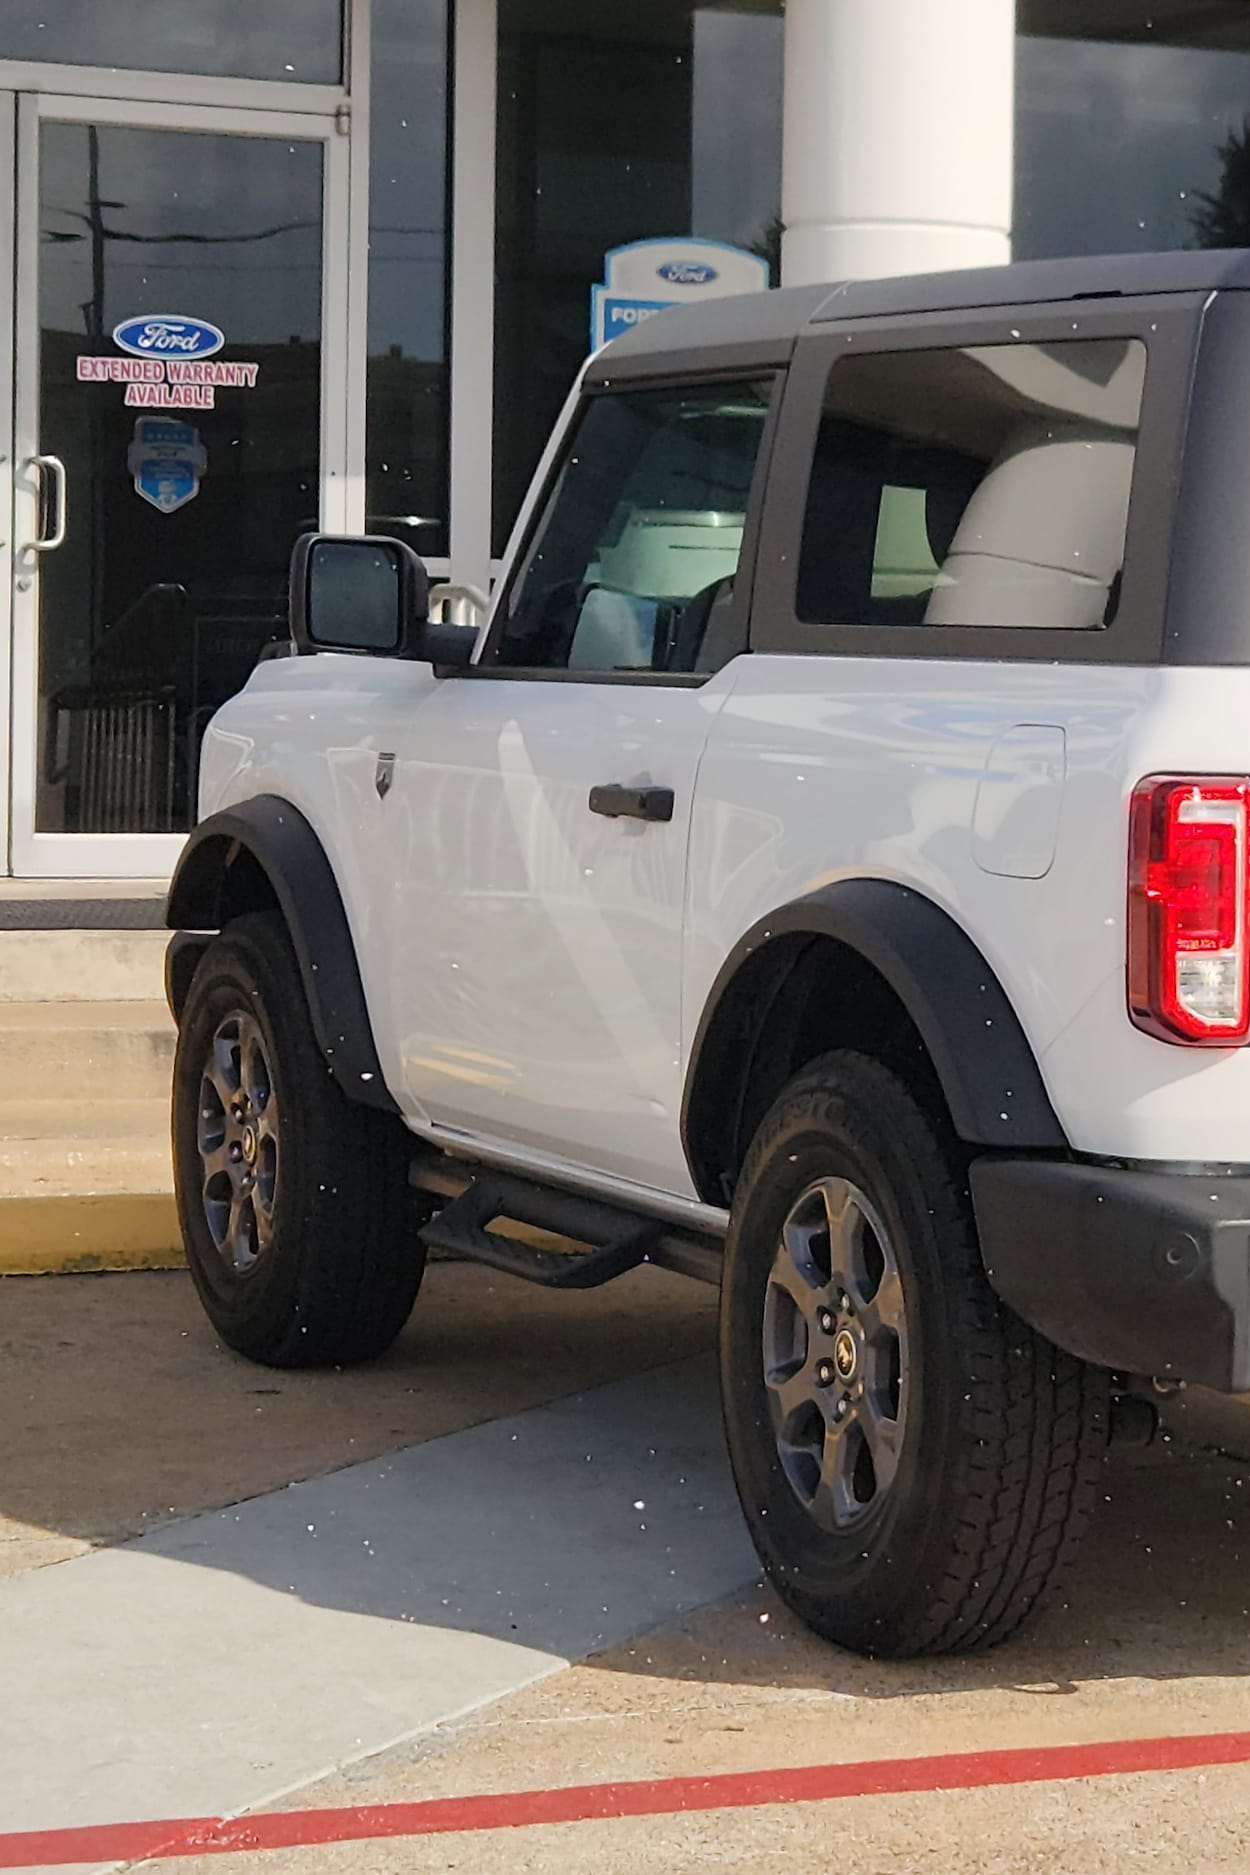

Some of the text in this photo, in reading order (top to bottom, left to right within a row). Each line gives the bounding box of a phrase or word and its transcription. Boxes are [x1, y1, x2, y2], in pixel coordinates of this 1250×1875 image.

[78, 358, 259, 387] EXTENDED WARRANTY
[125, 384, 214, 409] AVAILABLE
